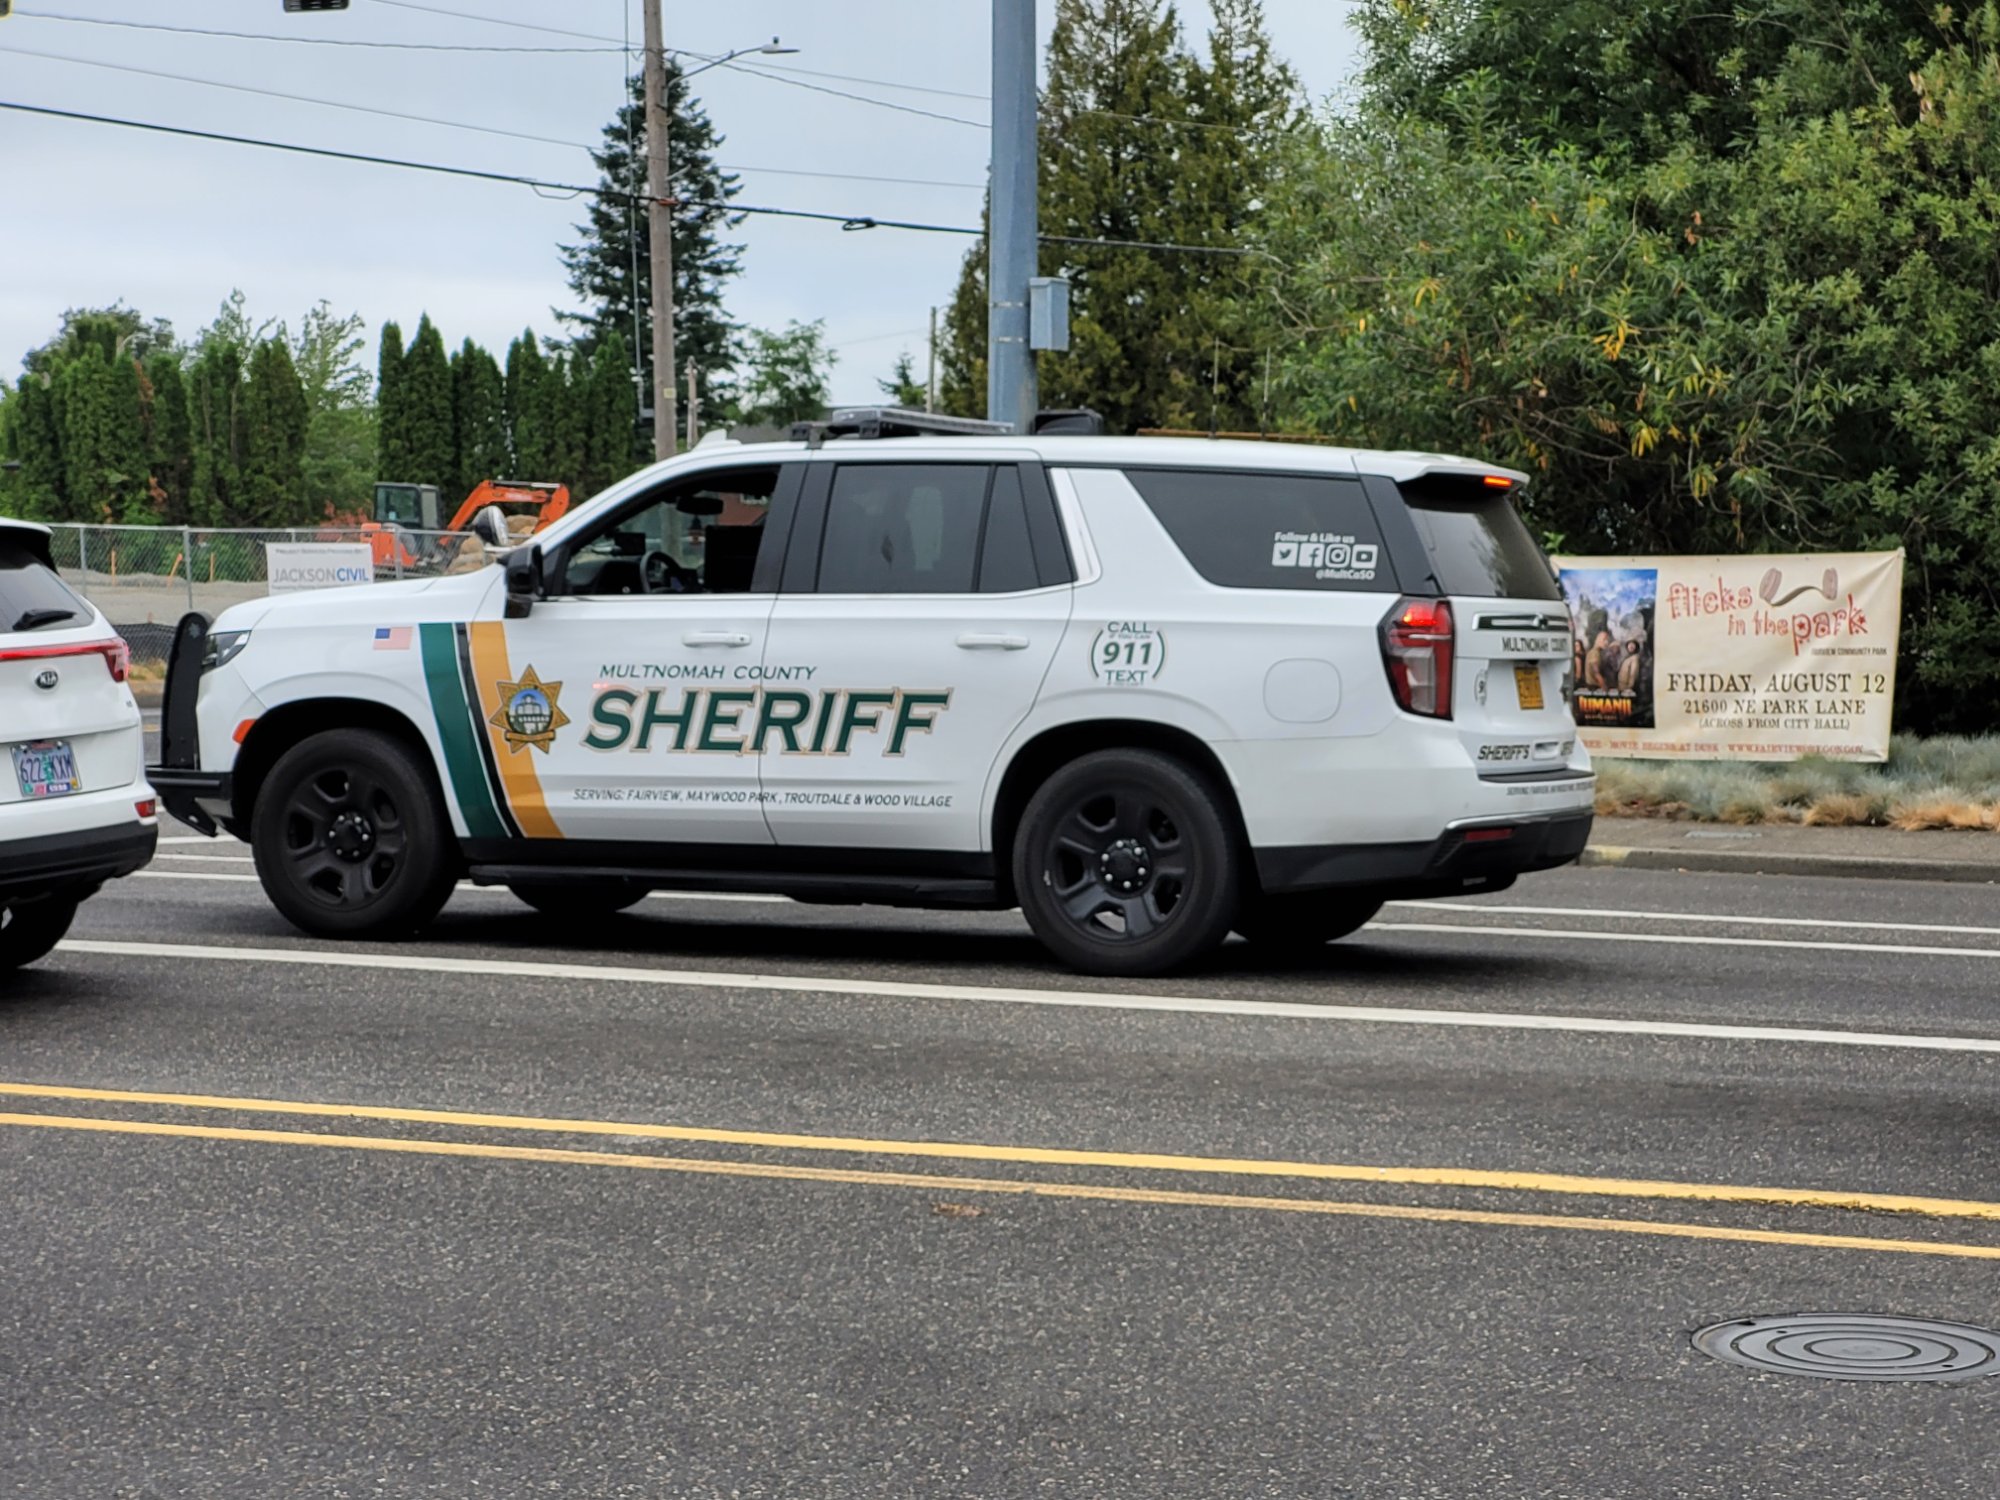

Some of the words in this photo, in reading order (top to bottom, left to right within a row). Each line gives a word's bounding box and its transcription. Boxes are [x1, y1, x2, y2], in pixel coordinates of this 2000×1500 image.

[1667, 576, 1753, 619] flicks
[1107, 621, 1153, 633] CALL
[1728, 614, 1746, 636] in
[1753, 610, 1789, 636] the
[1792, 593, 1868, 656] park
[1103, 641, 1152, 665] 911
[600, 664, 725, 679] MULTNOMAH
[733, 665, 817, 680] COUNTY
[1105, 669, 1148, 682] TEXT
[1667, 673, 1756, 694] FRIDAY,
[1764, 673, 1851, 694] AUGUST
[1862, 673, 1885, 694] 12
[1684, 700, 1728, 715] 21600
[1733, 700, 1756, 714] NE
[1763, 700, 1809, 714] PARK
[1816, 700, 1866, 714] LANE
[579, 684, 954, 758] SHERIFF
[1747, 718, 1780, 729] FROM
[1784, 718, 1809, 729] CITY
[1814, 719, 1850, 730] HALL)
[20, 757, 46, 783] 622
[573, 789, 624, 801] SERVING:
[627, 789, 683, 803] FAIRVIEW,
[686, 791, 747, 802] MAYWOOD
[784, 792, 851, 805] TROUTDALE
[853, 794, 861, 805] &
[864, 794, 900, 806] WOOD
[903, 795, 953, 807] VILLAGE
